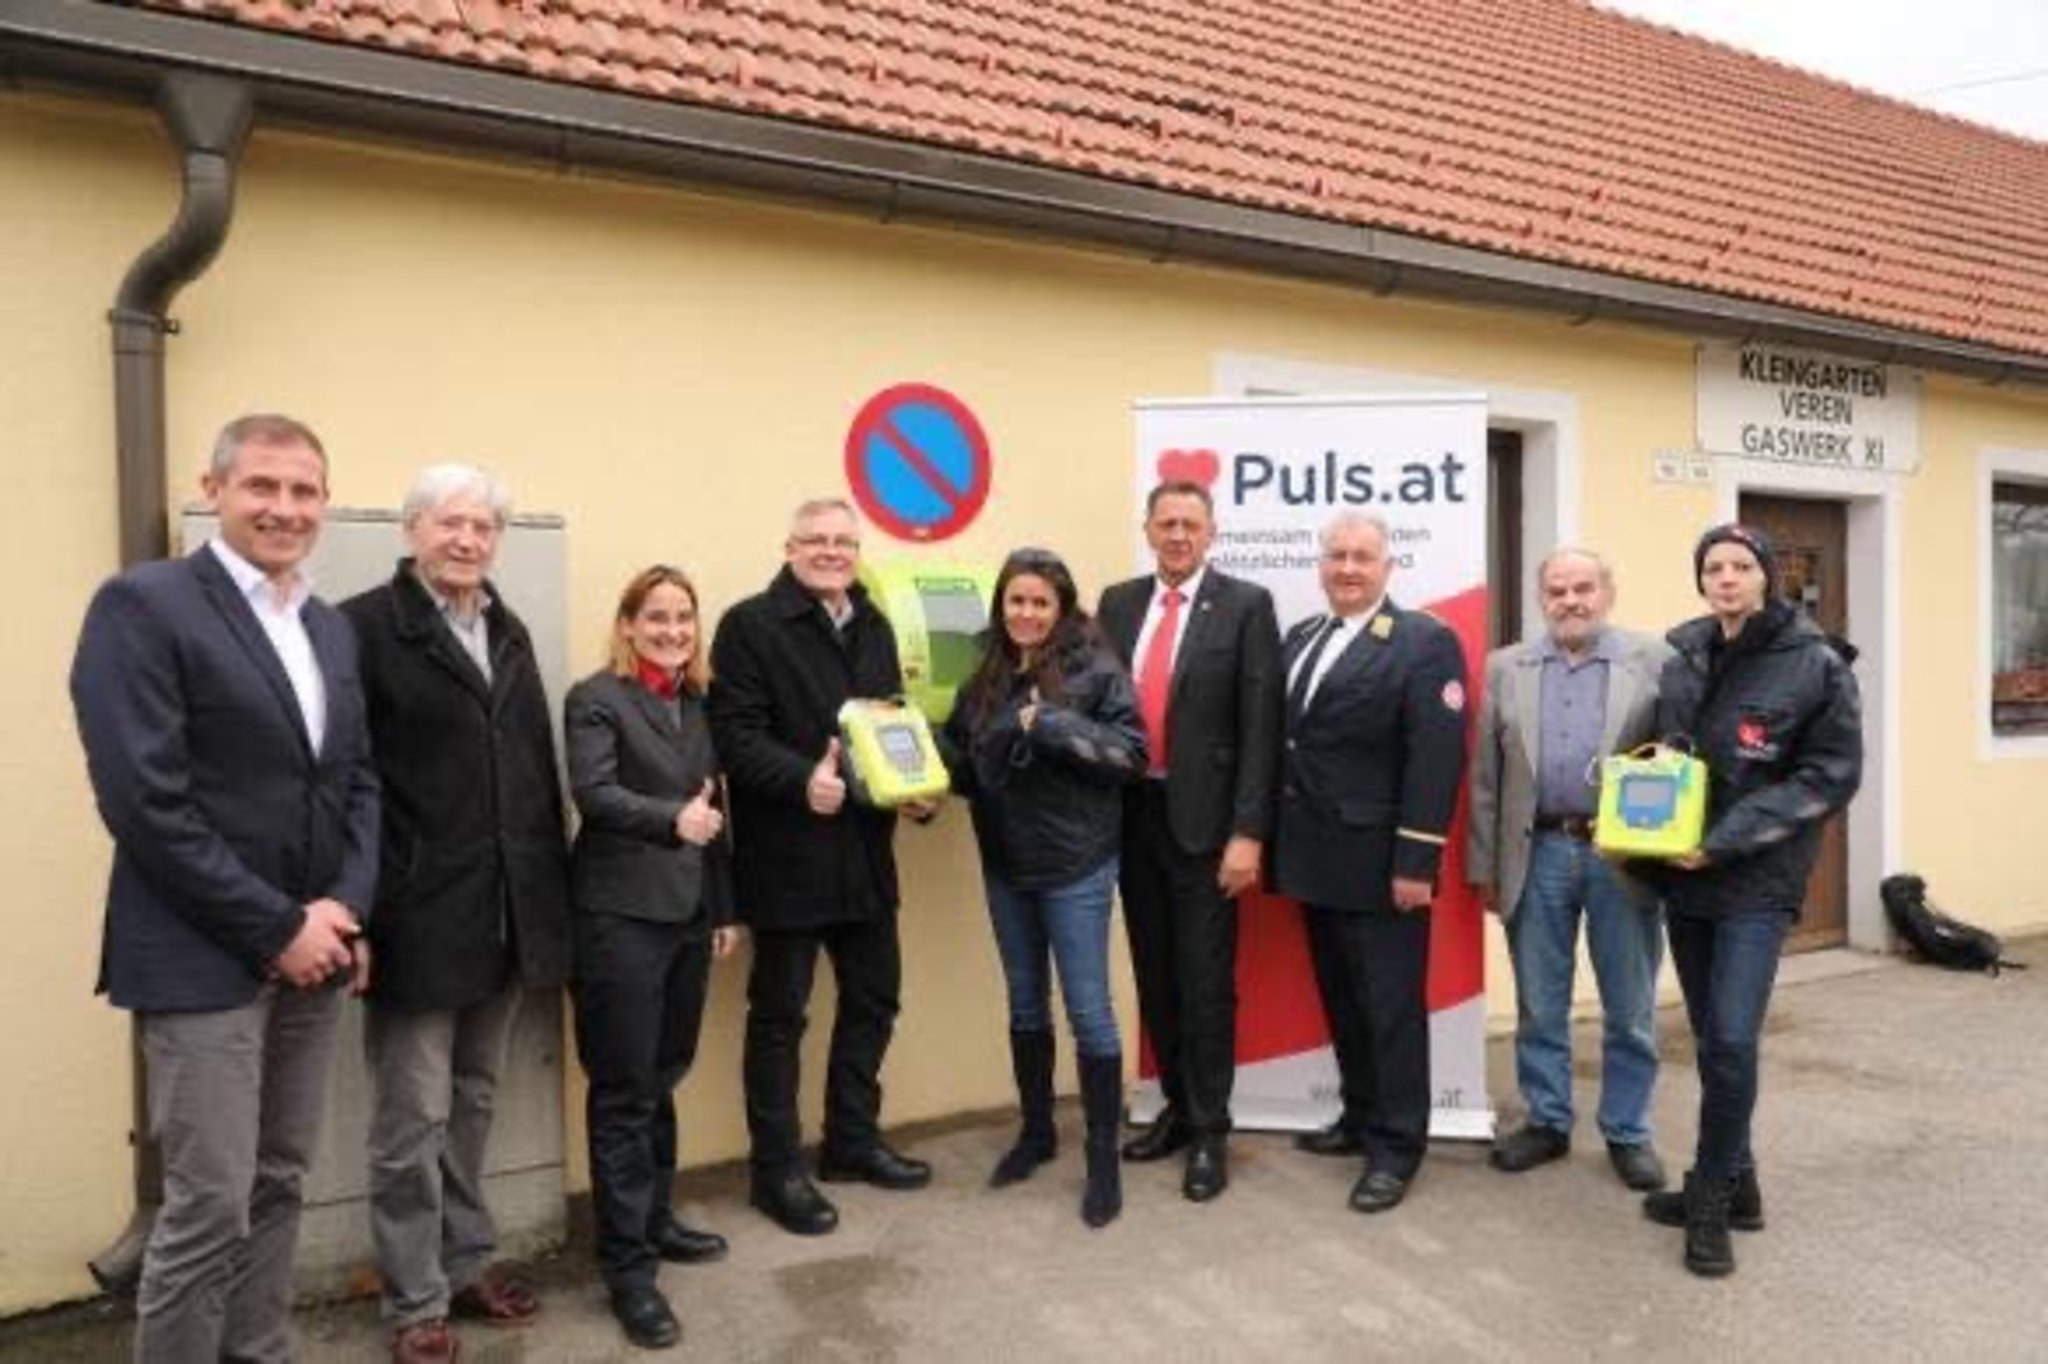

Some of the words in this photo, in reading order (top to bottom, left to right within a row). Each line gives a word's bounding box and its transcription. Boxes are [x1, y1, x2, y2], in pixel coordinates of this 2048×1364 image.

[1739, 350, 1888, 397] KLEINGARTEN
[1779, 390, 1853, 425] VEREIN
[1741, 423, 1852, 461] GASWERK
[1865, 436, 1884, 466] XI
[1232, 450, 1465, 506] Puls.at
[1216, 527, 1312, 546] meinsam
